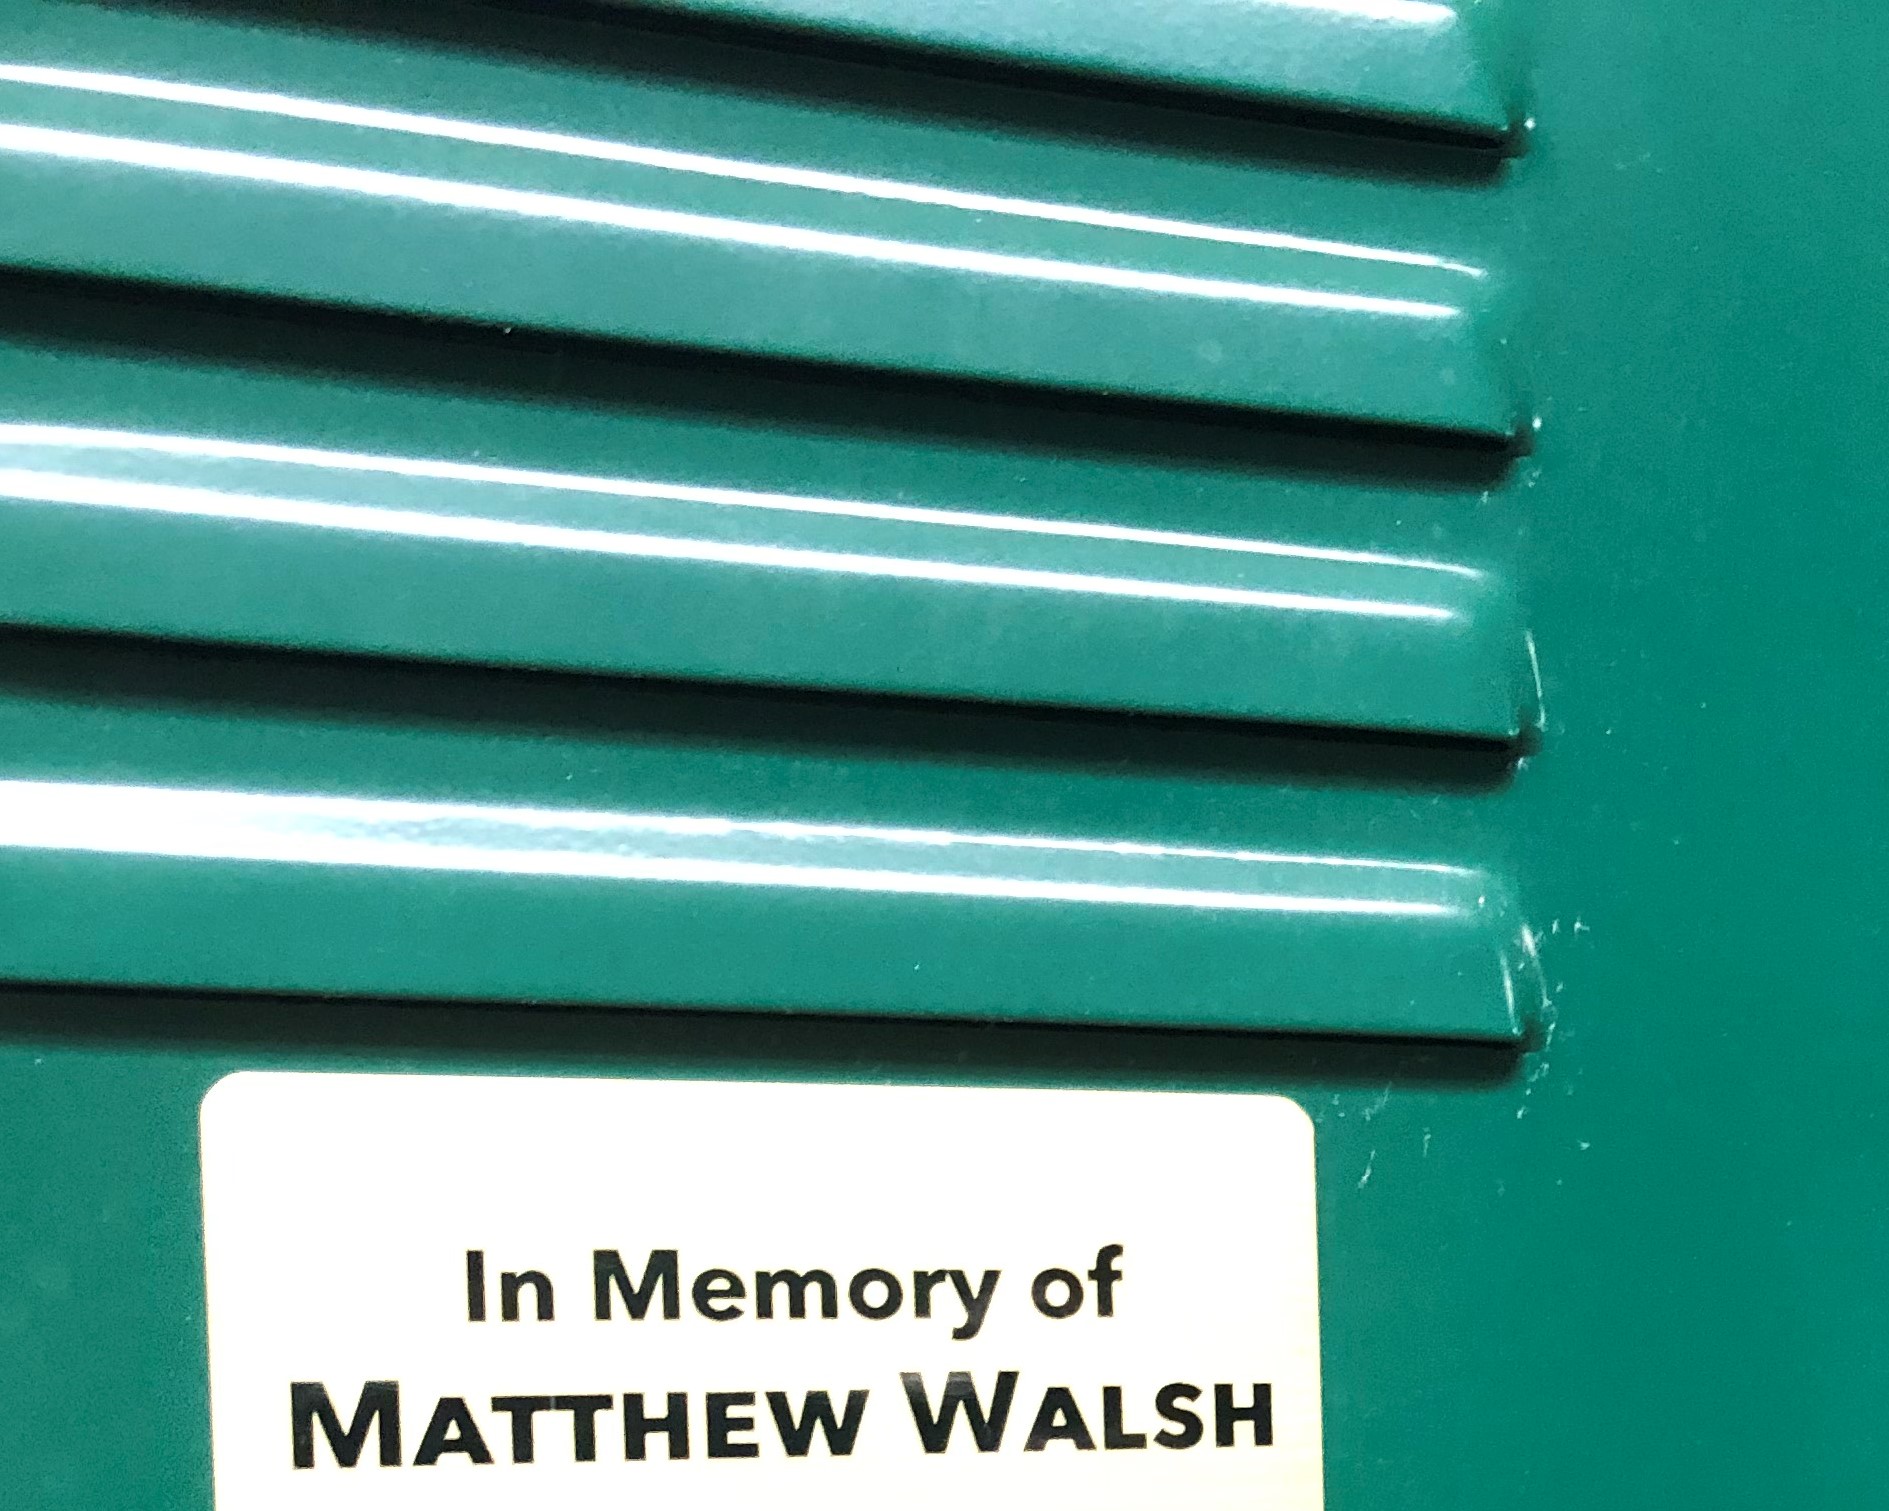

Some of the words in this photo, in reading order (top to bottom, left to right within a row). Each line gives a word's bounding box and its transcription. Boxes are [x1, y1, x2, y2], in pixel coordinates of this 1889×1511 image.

[466, 1250, 554, 1322] In
[593, 1249, 1001, 1341] Memory
[1031, 1243, 1124, 1319] of
[290, 1381, 869, 1470] MATTHEW
[899, 1370, 1274, 1454] WALSH
